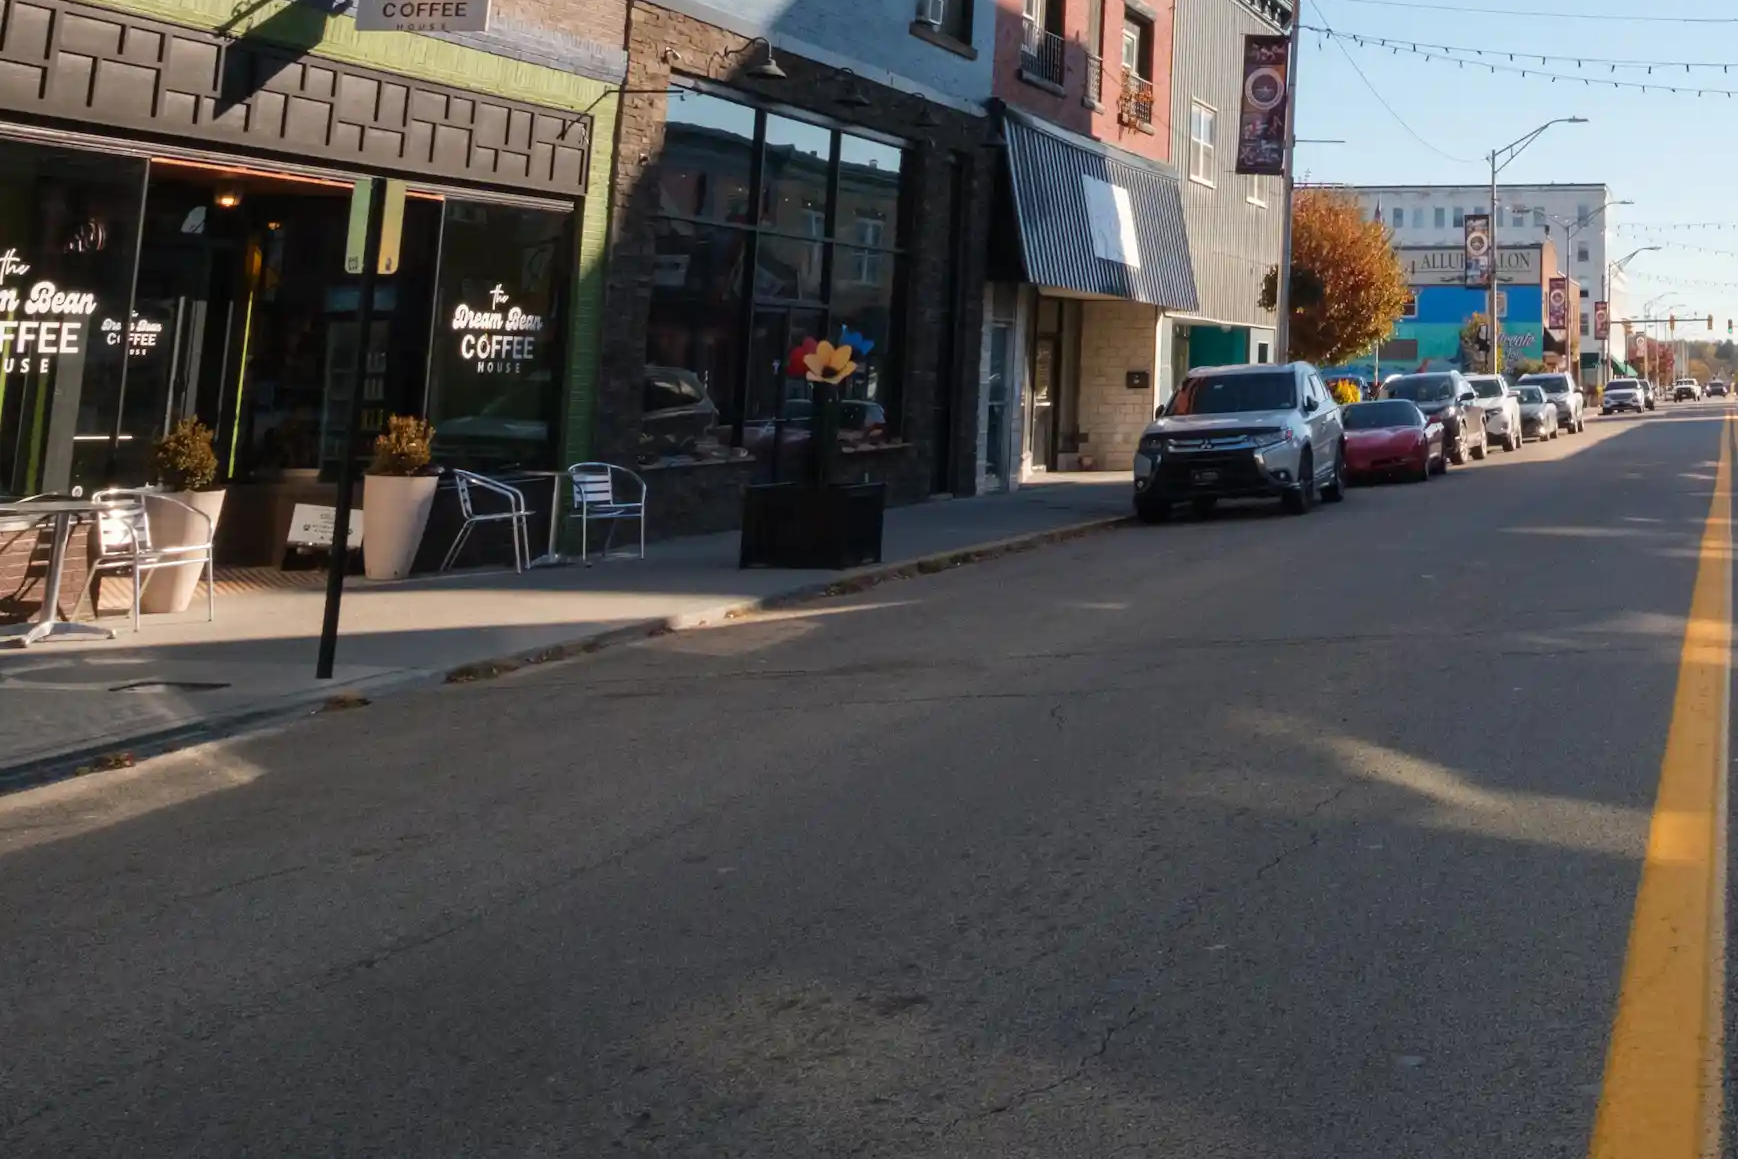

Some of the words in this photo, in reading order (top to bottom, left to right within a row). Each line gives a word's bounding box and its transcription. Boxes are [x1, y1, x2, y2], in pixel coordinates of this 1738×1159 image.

[382, 2, 467, 17] COFFEE
[0, 248, 30, 285] the
[25, 280, 97, 314] Bean
[490, 284, 509, 310] the
[453, 304, 503, 329] Dream
[505, 307, 542, 330] Bean
[107, 333, 157, 346] CFFEE
[461, 334, 534, 359] COFFEE
[477, 362, 520, 373] HOUSE
